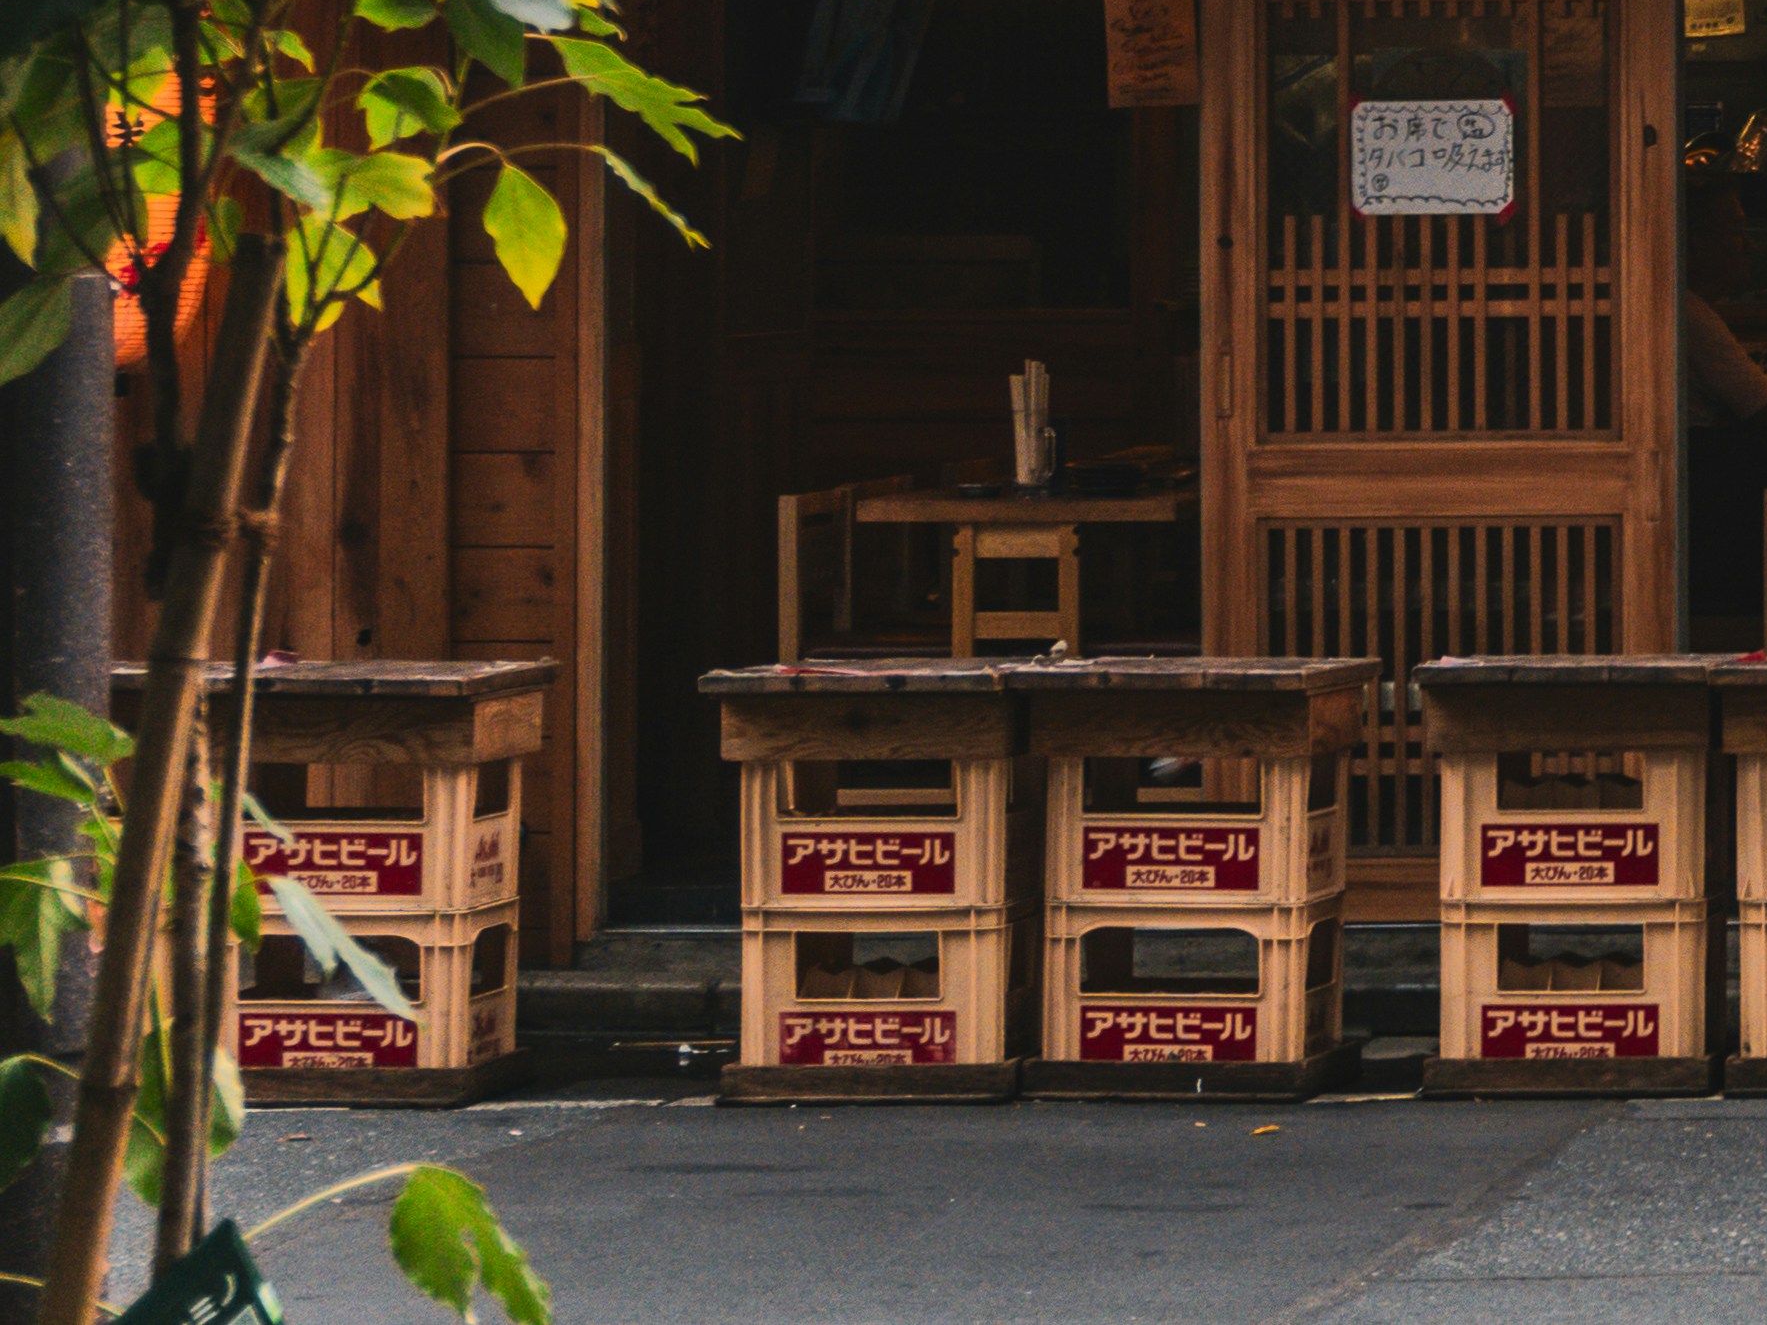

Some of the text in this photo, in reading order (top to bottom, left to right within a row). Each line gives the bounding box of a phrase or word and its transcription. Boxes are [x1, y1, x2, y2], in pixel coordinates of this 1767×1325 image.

[1372, 115, 1448, 142] お席で
[249, 837, 418, 868] アサヒビール
[787, 839, 952, 865] アサヒビール
[1087, 832, 1256, 862] アサヒビール
[1486, 828, 1656, 857] アサヒビール
[243, 1018, 414, 1048] アサヒビール
[785, 1016, 952, 1046] アサヒビール
[1084, 1011, 1254, 1041] アサヒビール
[1486, 1008, 1656, 1038] アサヒビール
